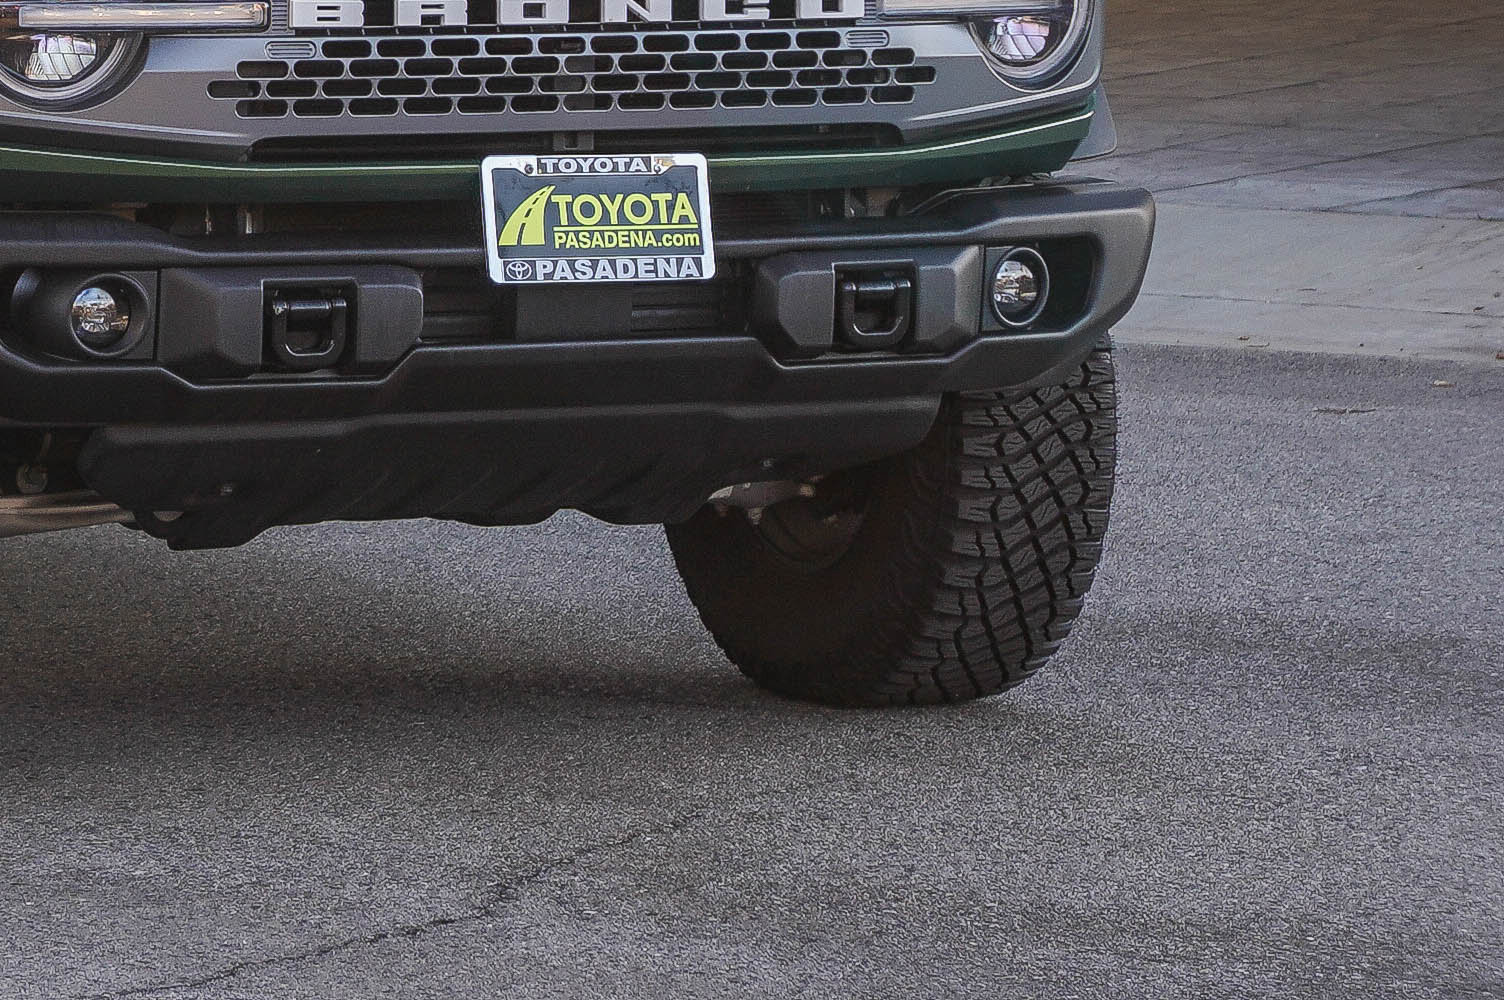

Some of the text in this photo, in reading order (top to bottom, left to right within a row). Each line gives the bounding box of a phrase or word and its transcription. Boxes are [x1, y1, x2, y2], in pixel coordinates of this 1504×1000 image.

[541, 157, 648, 174] TOYOTA
[551, 192, 698, 226] TOYOTA
[553, 231, 700, 249] PASADENA.com
[535, 258, 700, 281] PASADENA
